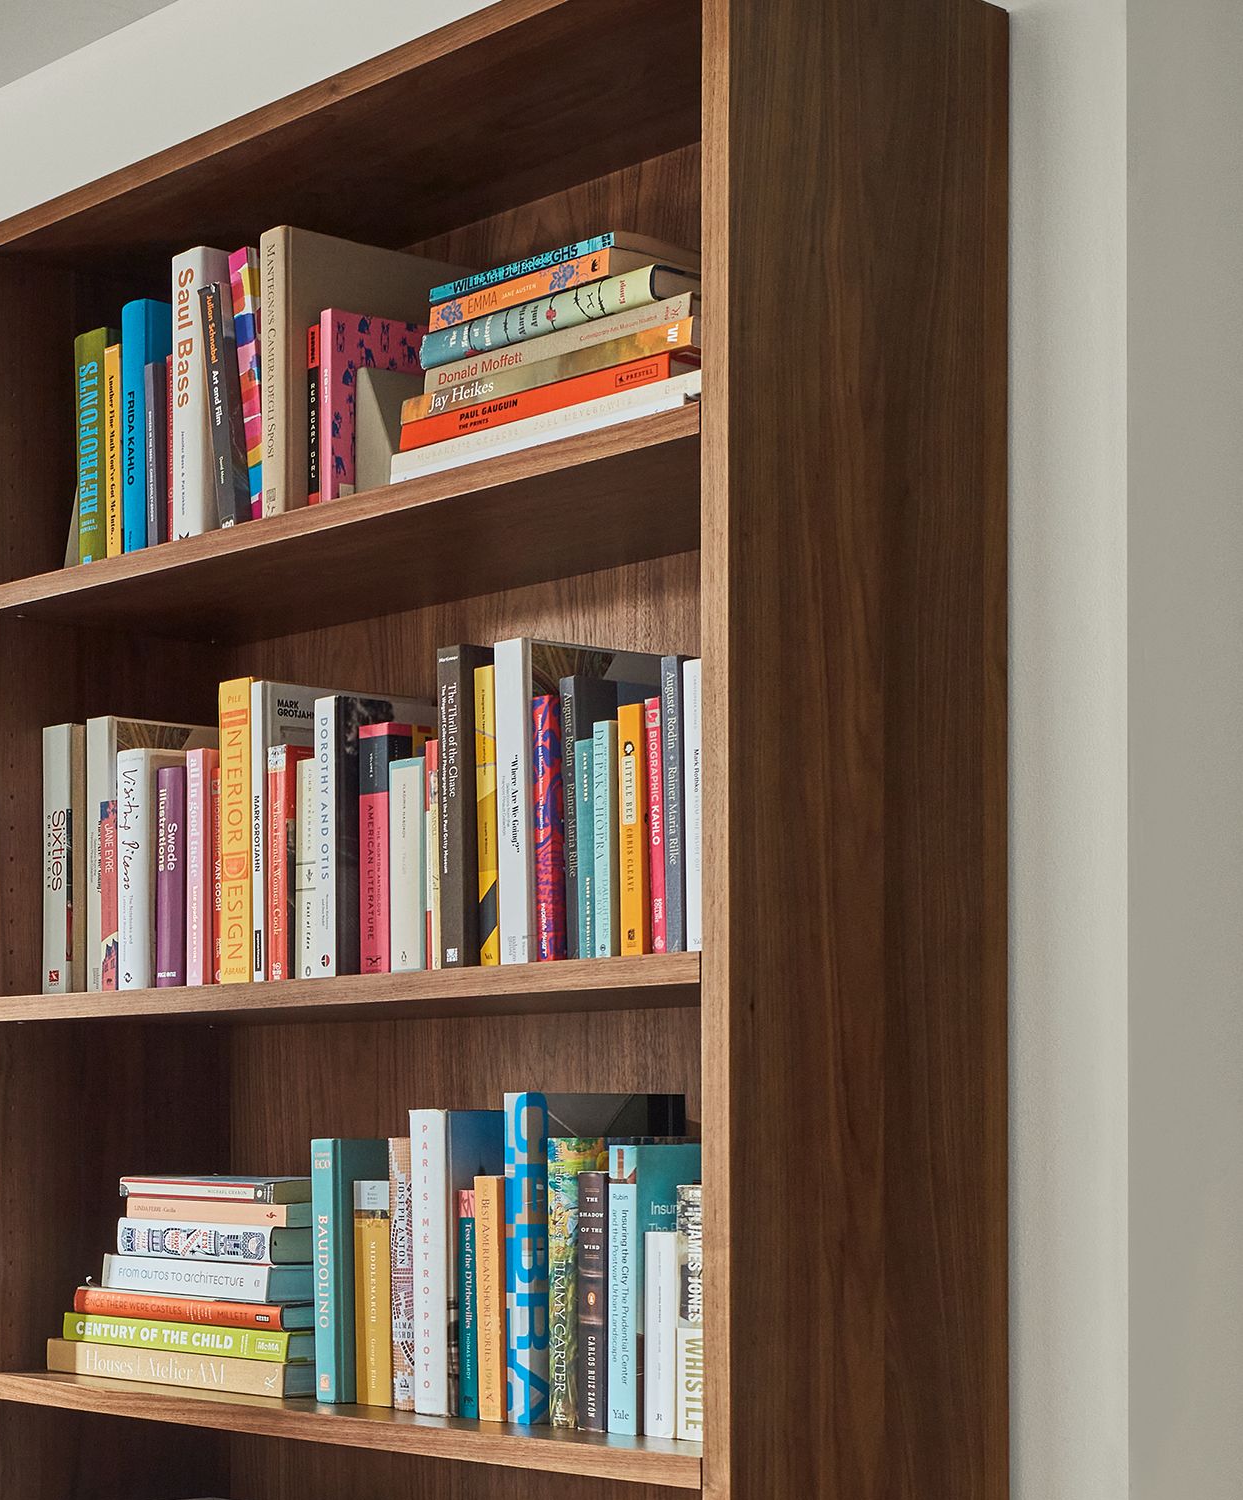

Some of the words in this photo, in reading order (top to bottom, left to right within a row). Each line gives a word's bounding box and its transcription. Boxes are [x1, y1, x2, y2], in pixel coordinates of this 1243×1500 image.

[177, 268, 195, 329] Saul
[205, 294, 218, 322] Julian
[467, 291, 498, 314] EMMA
[207, 323, 220, 364] Schnabel
[177, 338, 195, 408] Bass
[211, 370, 223, 386] Art
[438, 364, 478, 386] Donald
[480, 352, 523, 373] Moffett
[625, 369, 653, 381] PRESTEL
[212, 387, 223, 406] and
[309, 382, 317, 404] RED
[428, 393, 450, 413] Jay
[451, 381, 495, 403] Heikes
[127, 390, 135, 434] FRIDA
[214, 406, 225, 427] Film
[459, 410, 480, 421] PAUL
[481, 399, 518, 415] GAUGUIN
[469, 418, 490, 428] PRINTS
[78, 361, 99, 516] RETROFONTS
[309, 410, 317, 445] SCARF
[127, 436, 135, 486] KAHLO
[309, 451, 317, 479] GIRL
[276, 698, 299, 710] MARK
[446, 682, 458, 705] The
[665, 671, 677, 715] Auguste
[447, 705, 458, 735] Thrill
[560, 692, 574, 734] Auguste
[447, 735, 458, 747] of
[666, 717, 678, 750] Rodin
[319, 716, 330, 795] DOROTHY
[448, 748, 458, 765] the
[564, 735, 576, 767] Rodin
[648, 730, 660, 803] BIOGRAPHIC
[221, 708, 249, 844] INTERIOR
[448, 766, 459, 798] Chase
[624, 759, 634, 798] LITTLE
[667, 766, 678, 802] Rainer
[253, 795, 261, 821] MARK
[566, 782, 577, 817] Rainer
[624, 801, 635, 821] BEE
[104, 823, 114, 848] JANE
[157, 788, 167, 873] illustrations
[320, 802, 329, 838] AND
[366, 804, 375, 865] AMERICAN
[567, 817, 578, 850] Maria
[650, 804, 661, 846] KAHLO
[667, 803, 679, 837] Maria
[51, 810, 66, 891] Sixties
[104, 849, 114, 874] EYRE
[166, 822, 178, 872] Swede
[252, 822, 262, 873] GROTJAHN
[320, 843, 331, 881] OTIS
[668, 838, 680, 866] Rilke
[568, 850, 579, 878] Rilke
[221, 851, 249, 961] DESIGN
[366, 869, 375, 941] LITERATURE
[397, 1181, 406, 1223] JOSEPH
[579, 1211, 604, 1219] SHADOW
[620, 1209, 630, 1247] Insuring
[397, 1226, 407, 1266] ANTON
[583, 1243, 601, 1251] WIND
[621, 1248, 629, 1264] the
[317, 1215, 330, 1330] BAUDOLINO
[620, 1265, 630, 1286] City
[621, 1287, 629, 1303] The
[75, 1321, 137, 1341] CENTURY
[139, 1327, 159, 1342] OF
[162, 1329, 189, 1345] THE
[191, 1332, 234, 1350] CHILD
[621, 1305, 630, 1353] Prudential
[85, 1349, 134, 1374] Houses
[148, 1356, 194, 1380] Atelier
[197, 1362, 226, 1384] AM
[587, 1335, 596, 1367] CARLOS
[588, 1370, 596, 1390] RUIZ
[621, 1354, 629, 1385] Center
[685, 1338, 703, 1431] WHISTLE
[588, 1392, 597, 1418] ZAFÓN
[612, 1409, 630, 1422] Yale
